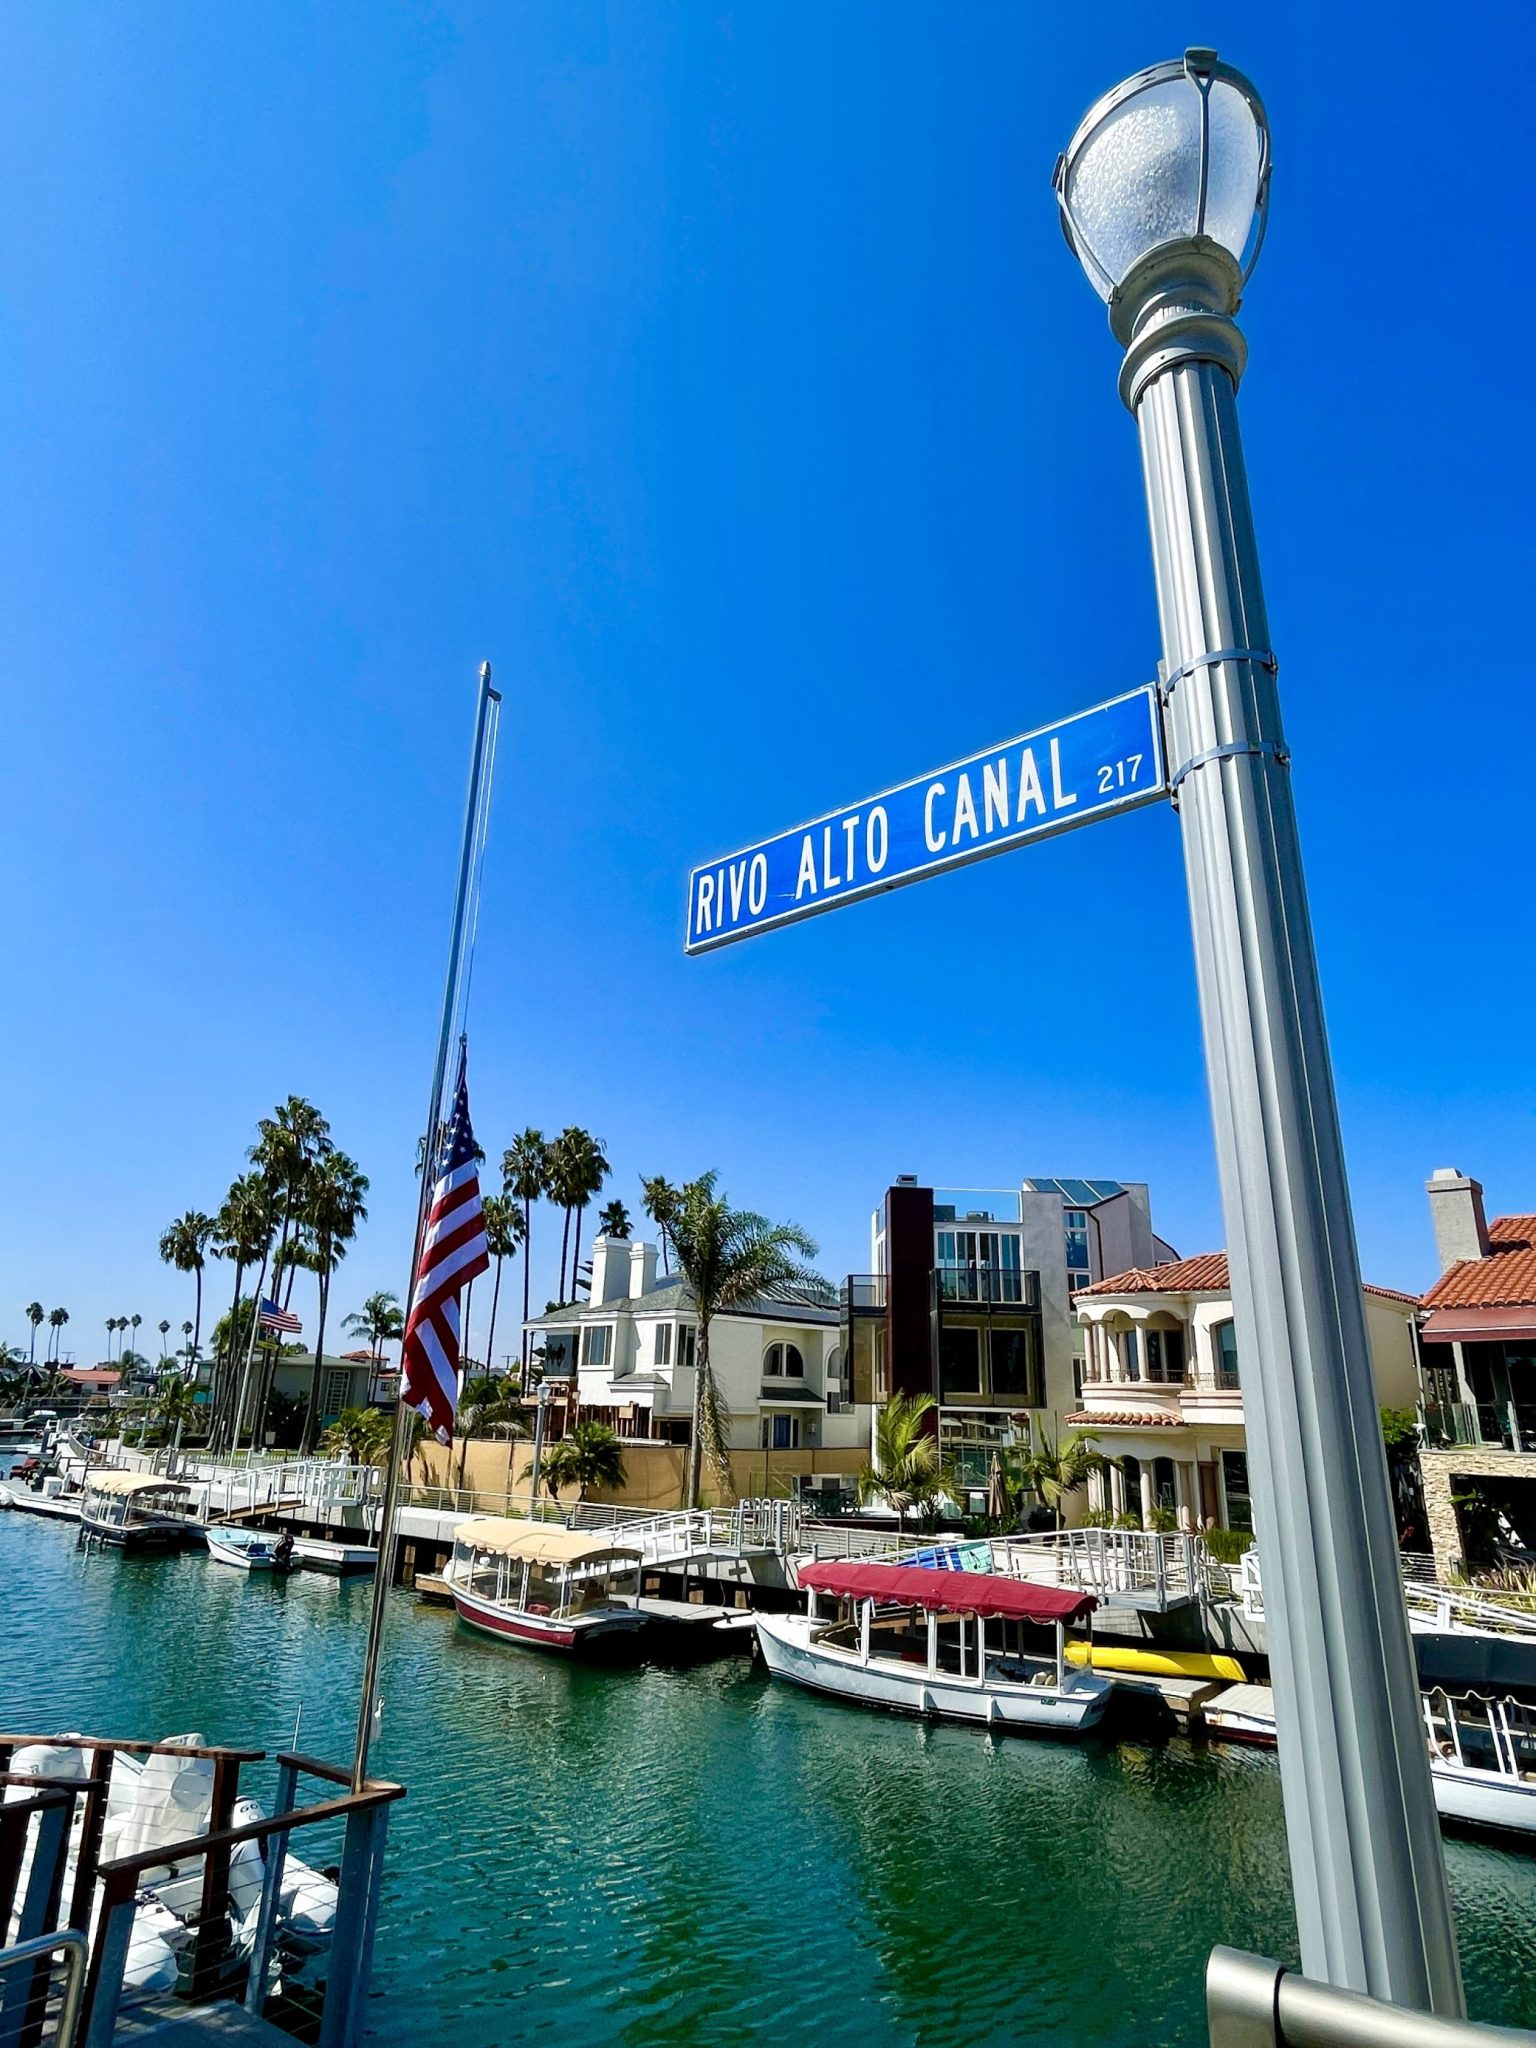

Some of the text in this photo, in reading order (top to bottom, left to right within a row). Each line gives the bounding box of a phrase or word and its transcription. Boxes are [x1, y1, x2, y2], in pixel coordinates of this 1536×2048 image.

[696, 737, 1143, 935] RIVO ALTO CANAL 217
